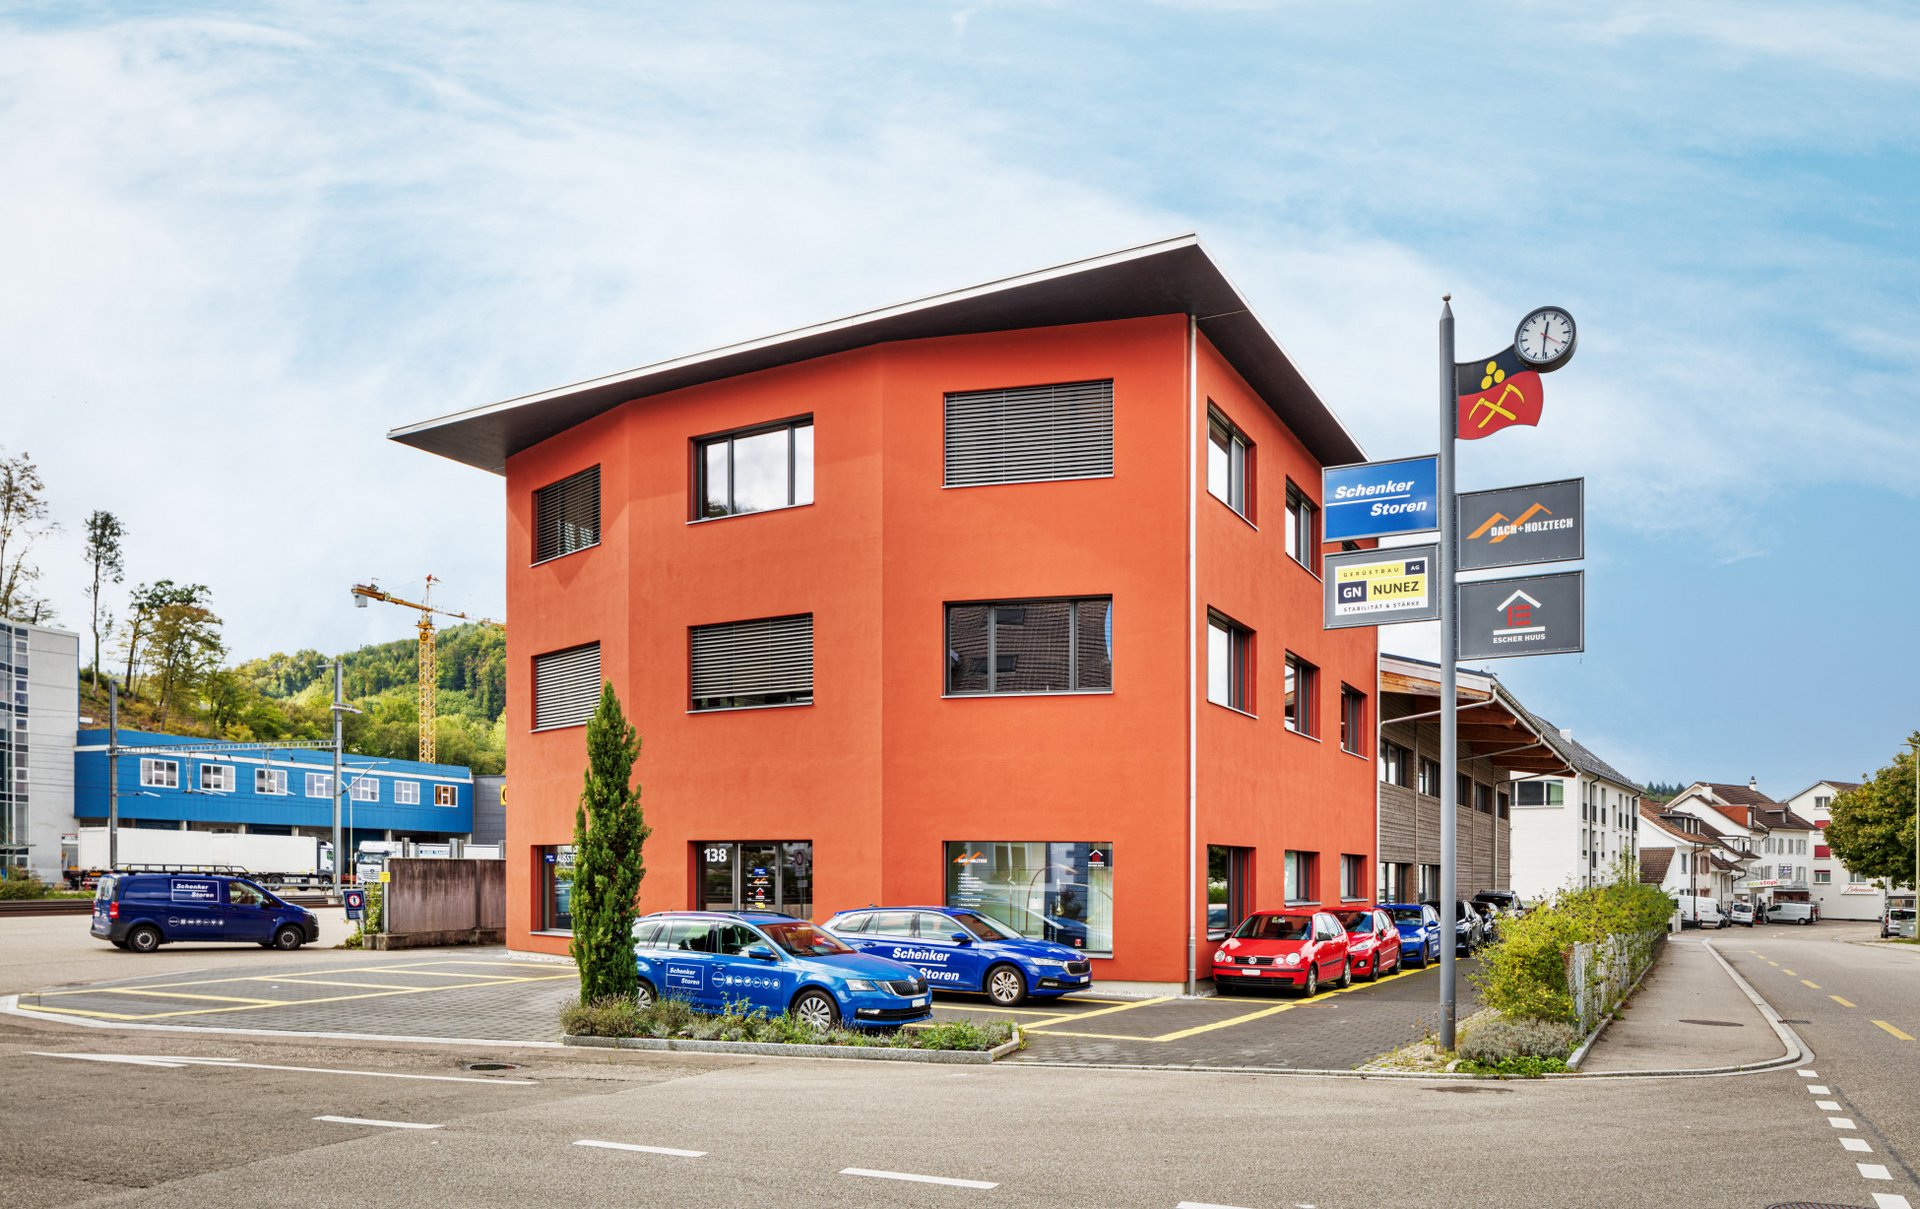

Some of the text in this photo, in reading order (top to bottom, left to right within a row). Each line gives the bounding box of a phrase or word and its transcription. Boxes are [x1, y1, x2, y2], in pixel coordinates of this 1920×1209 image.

[1334, 480, 1415, 499] Schenker
[1370, 501, 1427, 516] Storen
[1343, 567, 1399, 578] GERÜSTBAU
[1343, 586, 1362, 599] GN
[1373, 580, 1419, 596] NUNEZ
[1343, 604, 1383, 613] STABILITÄT
[1393, 600, 1420, 609] STÄRKE
[1493, 633, 1546, 644] ESCHER HUUS
[704, 848, 727, 862] 138
[892, 947, 951, 962] Schenker
[669, 967, 697, 976] Schenker
[681, 977, 700, 986] Storen
